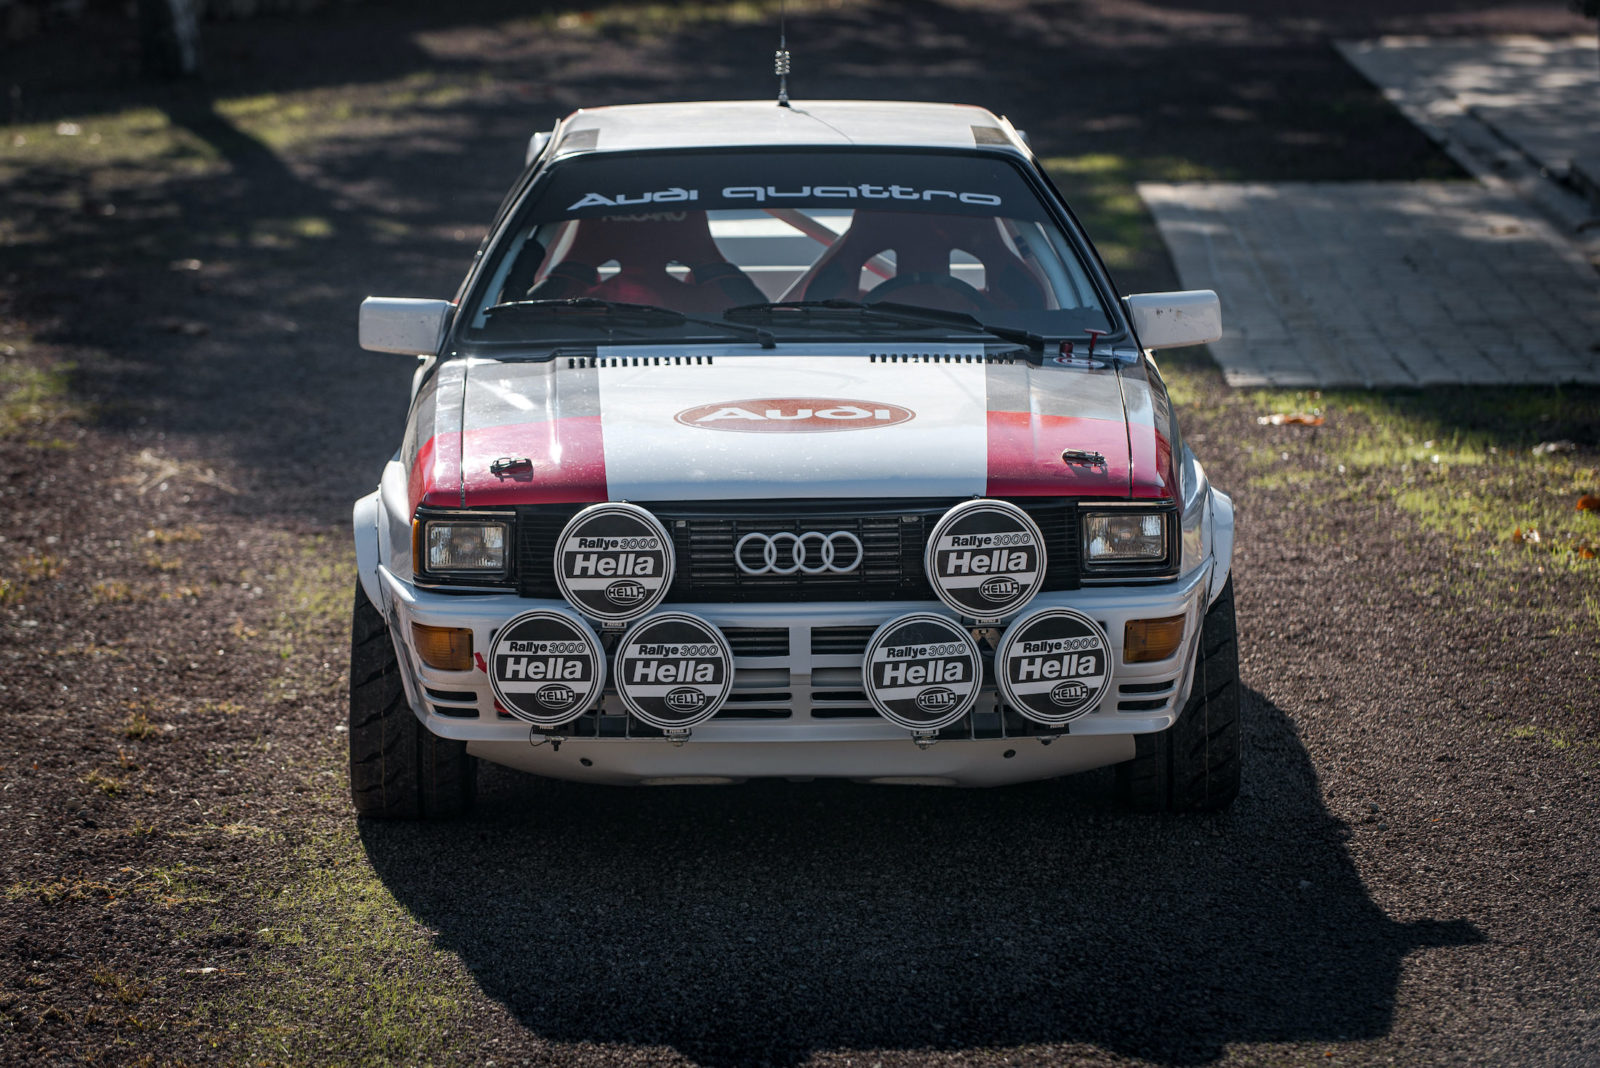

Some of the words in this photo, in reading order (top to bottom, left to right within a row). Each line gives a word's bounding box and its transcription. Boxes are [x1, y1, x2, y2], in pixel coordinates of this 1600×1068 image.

[567, 187, 698, 211] Audi
[722, 184, 1002, 207] quattro
[695, 405, 891, 423] Audi
[578, 538, 619, 550] Rallye
[620, 538, 658, 550] 3000
[951, 536, 992, 548] Rallye
[993, 533, 1031, 546] 3000
[573, 553, 655, 576] Hella
[946, 549, 1028, 575] Hella
[608, 586, 646, 599] HELLA
[982, 581, 1020, 594] HELLA
[509, 641, 548, 655] Rallye
[548, 642, 586, 654] 3000
[638, 644, 679, 658] Rallye
[680, 645, 718, 657] 3000
[886, 645, 927, 659] Rallye
[928, 643, 967, 657] 3000
[1022, 640, 1062, 654] Rallye
[1063, 637, 1100, 651] 3000
[504, 657, 583, 680] Hella
[632, 660, 715, 683] Hella
[882, 659, 964, 687] Hella
[1018, 653, 1097, 681] Hella
[538, 689, 576, 701] HELLA
[668, 693, 706, 706] HELLA
[919, 692, 957, 706] HELLA
[1053, 684, 1089, 700] HELLA
